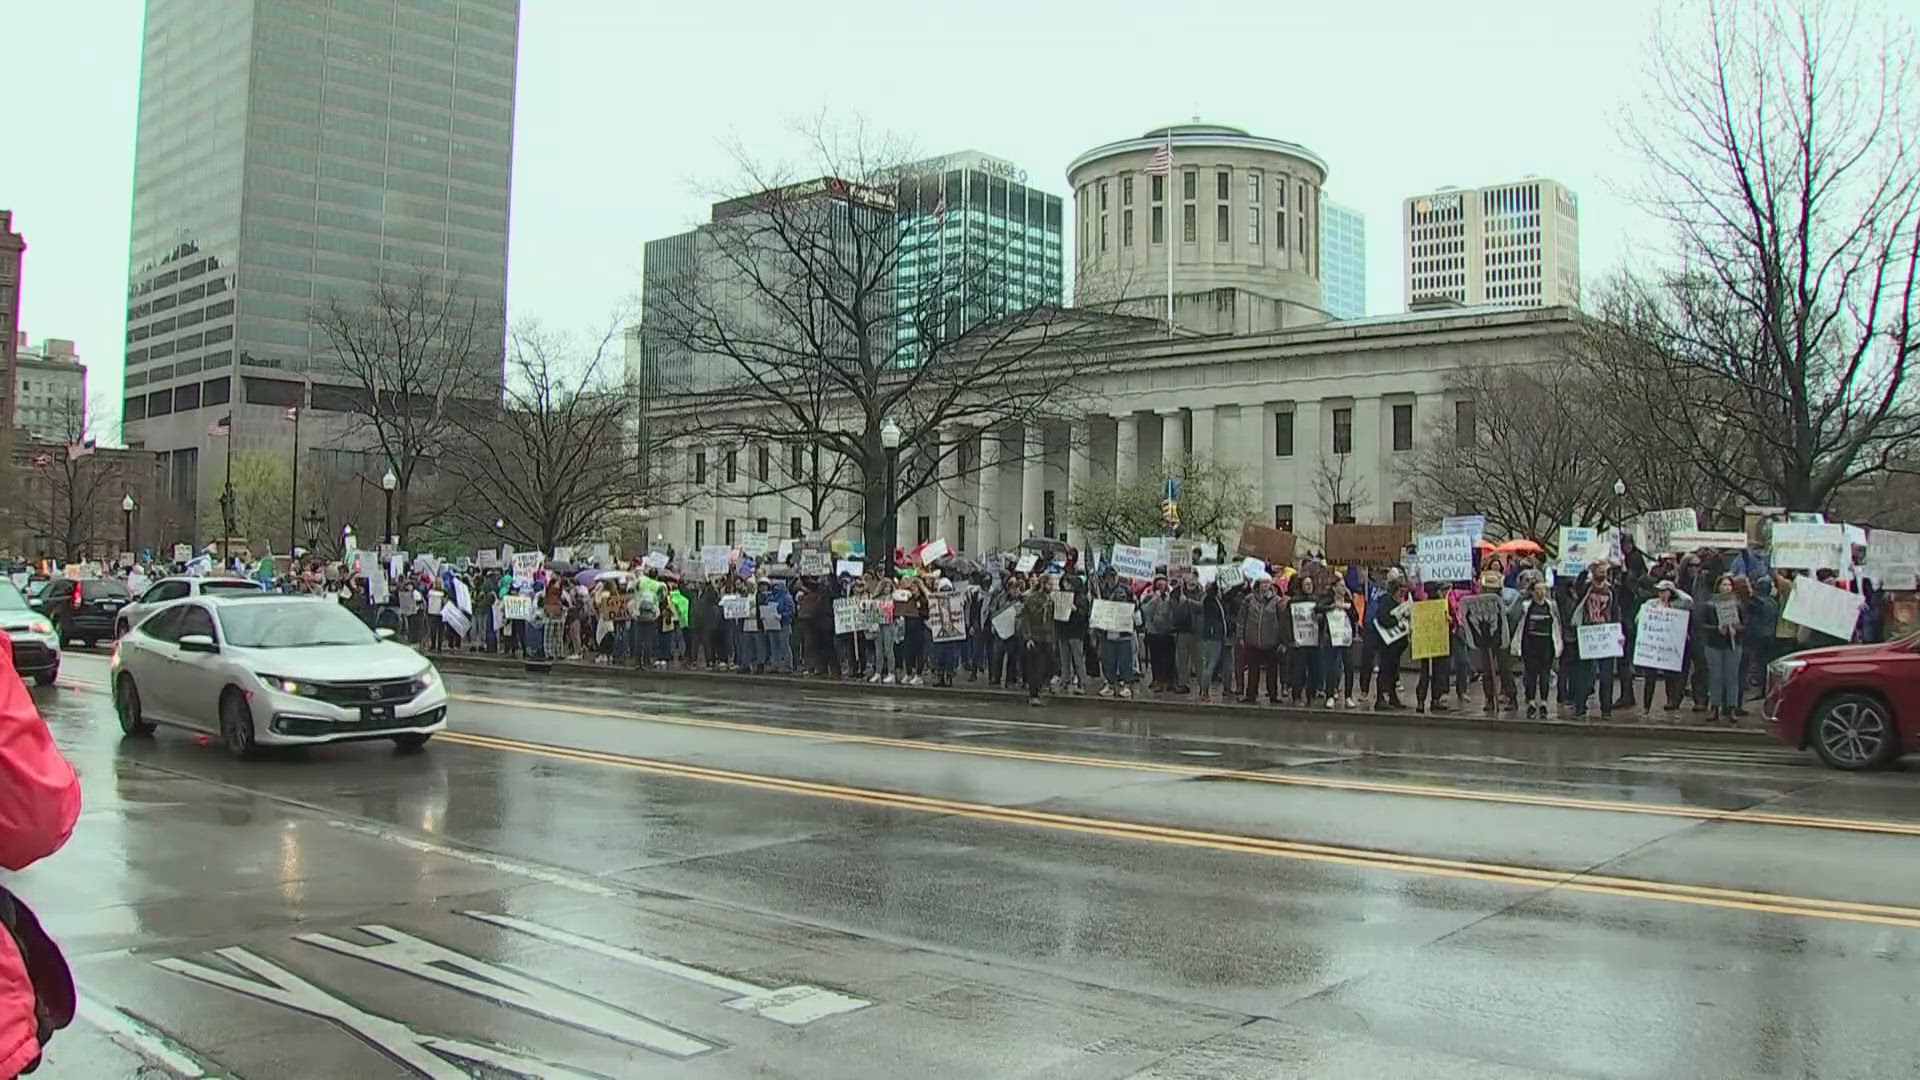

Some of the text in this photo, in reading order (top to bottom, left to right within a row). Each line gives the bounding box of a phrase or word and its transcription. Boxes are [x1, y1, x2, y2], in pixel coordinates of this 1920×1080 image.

[980, 157, 1017, 179] CHASE
[1432, 194, 1459, 210] PNC
[1424, 538, 1468, 549] MORAL
[1115, 554, 1152, 569] EXECUTIVE
[1417, 553, 1470, 564] COURAGE
[1431, 567, 1466, 578] NOW
